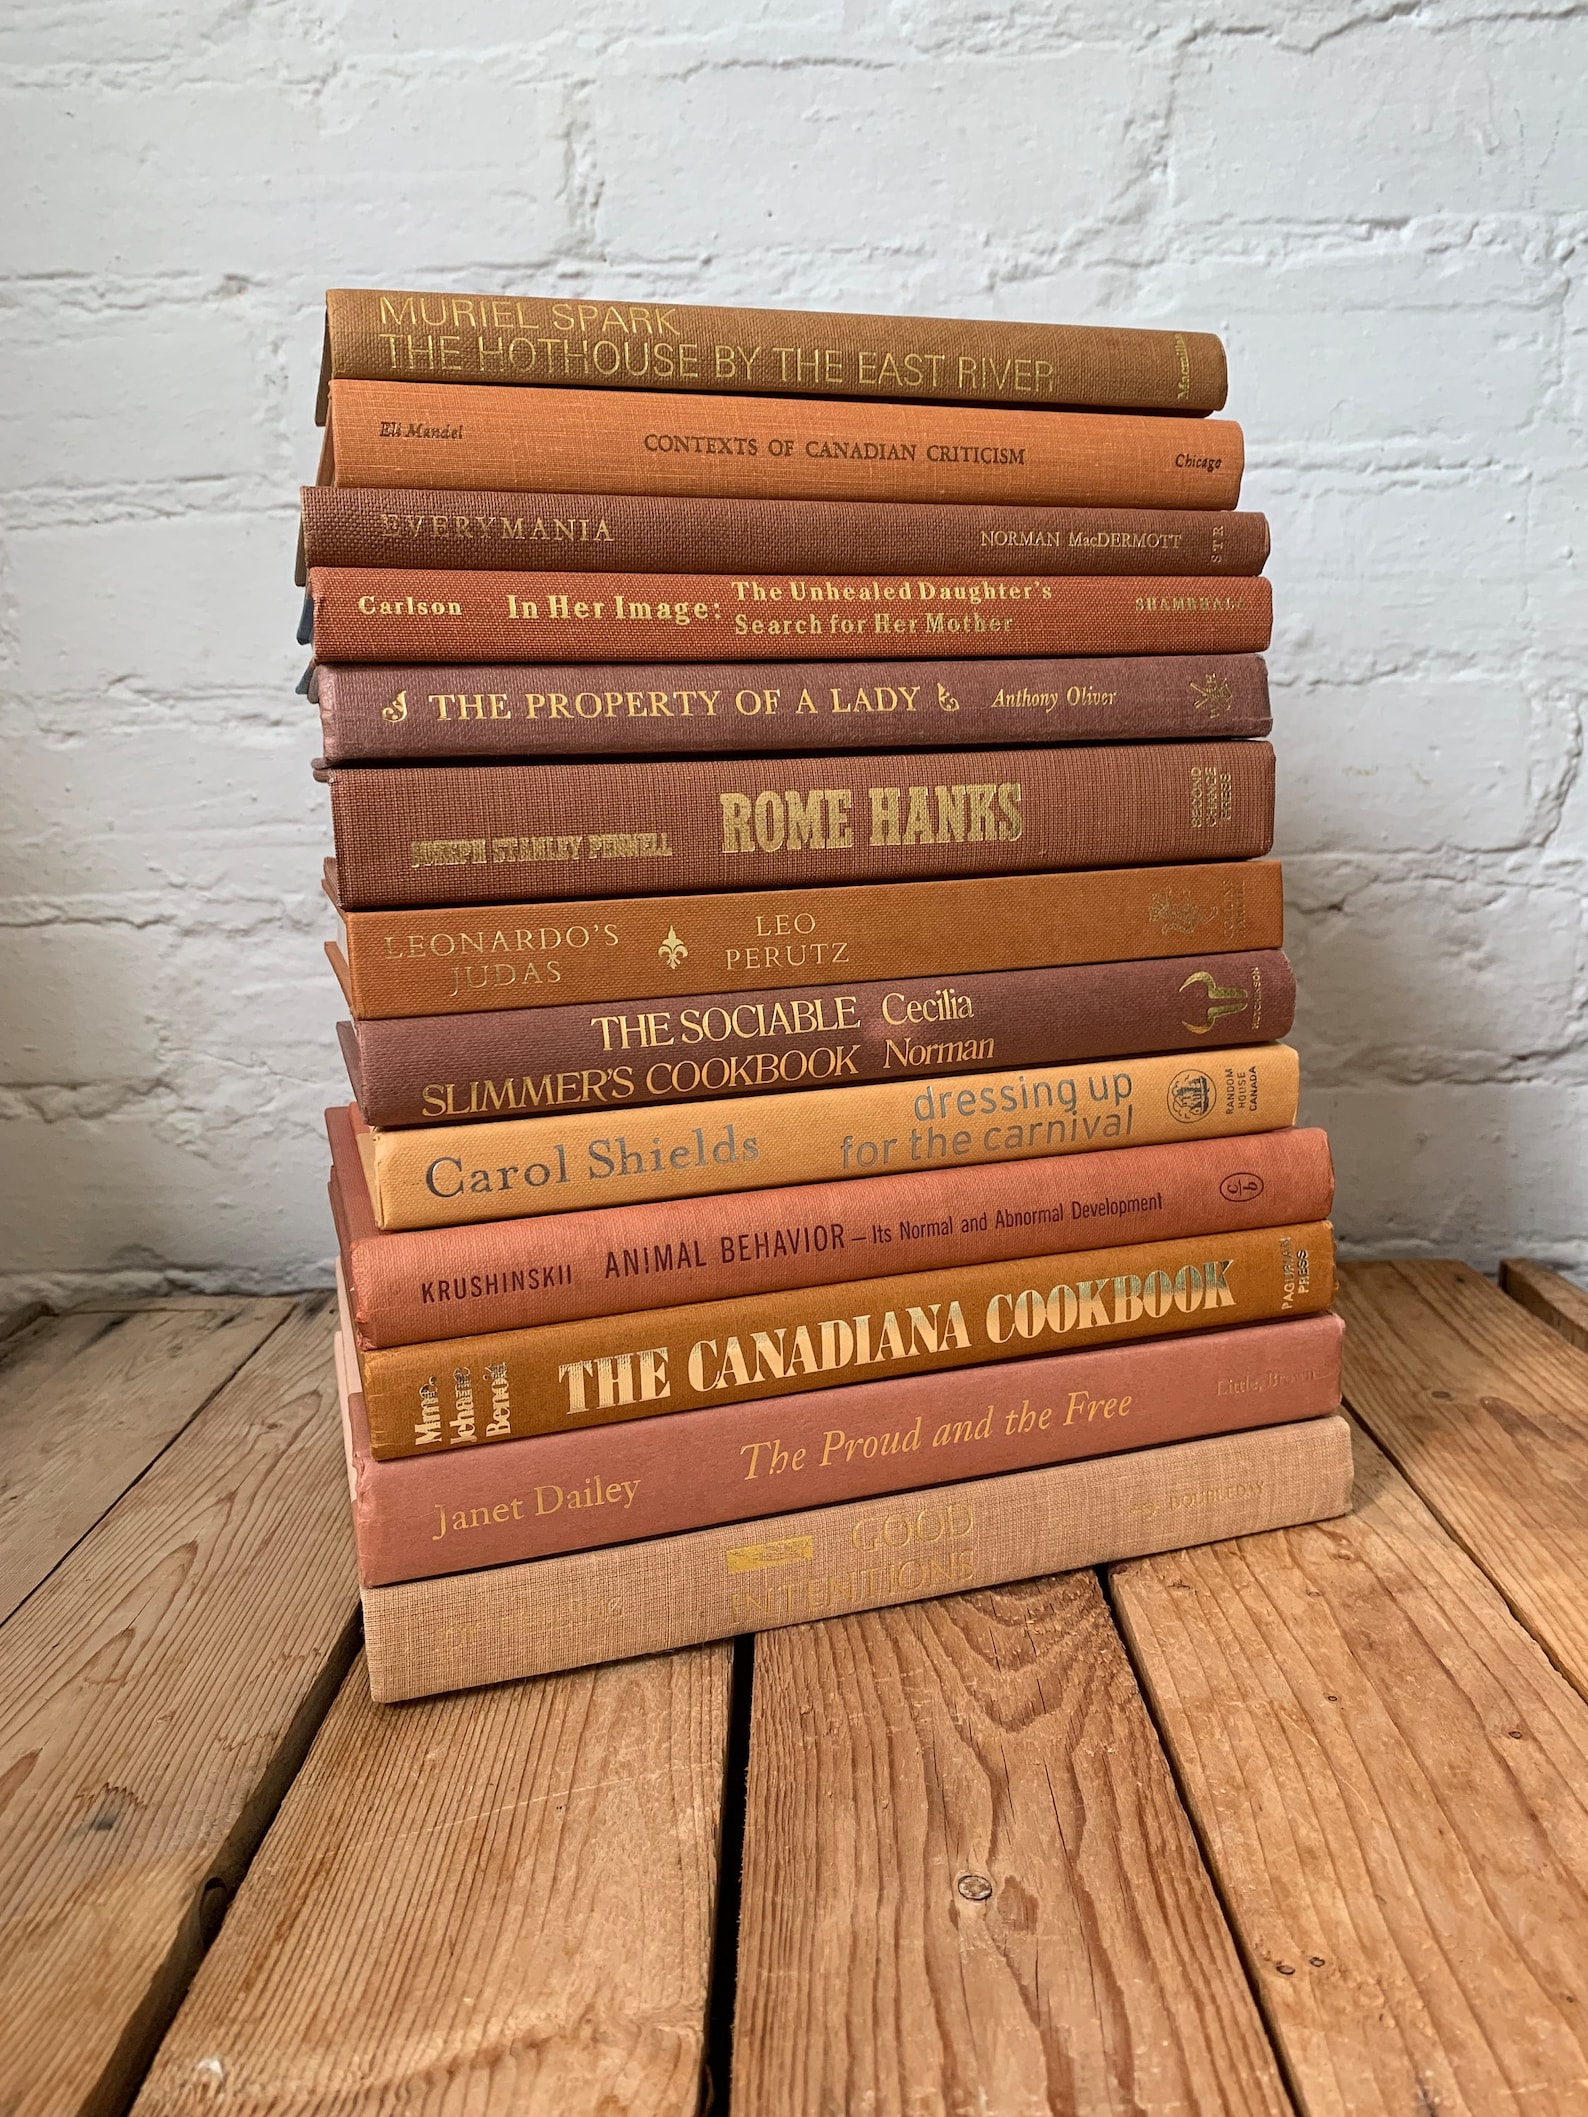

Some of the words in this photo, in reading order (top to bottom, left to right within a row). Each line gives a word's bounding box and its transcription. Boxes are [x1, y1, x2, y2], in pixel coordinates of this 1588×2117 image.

[379, 296, 539, 330] MURIEL
[552, 303, 680, 336] SPARK
[379, 333, 462, 371] THE
[478, 336, 699, 378] HOTHOUSE
[715, 345, 766, 381] BY
[773, 347, 842, 385] THE
[859, 351, 945, 389] EAST
[958, 356, 1054, 393] RIVER
[1175, 332, 1190, 400] Macmillan
[379, 421, 402, 438] Eli
[406, 423, 464, 440] Mandel
[644, 434, 758, 457] CONTEXTS
[768, 438, 795, 457] OF
[805, 440, 917, 462] CANADIAN
[927, 445, 1026, 466] CRITICISM
[1175, 453, 1223, 472] Chicago
[381, 513, 614, 542] EVERYMANIA
[980, 530, 1060, 548] NORMAN
[1069, 531, 1182, 550] MacDERMOTT
[358, 595, 463, 616] Carlson
[507, 594, 540, 619] In
[548, 595, 603, 619] Her
[614, 596, 722, 626] Image:
[731, 581, 782, 602] The
[789, 581, 911, 602] Unhealed
[919, 580, 1052, 605] Daughter's
[734, 614, 823, 635] Search
[828, 612, 866, 634] for
[874, 613, 917, 633] Her
[926, 612, 1014, 633] Mother
[429, 693, 512, 722] THE
[525, 690, 721, 720] PROPERTY
[735, 688, 781, 715] OF
[795, 688, 818, 715] A
[829, 685, 920, 713] LADY
[991, 688, 1059, 713] Anthony
[1067, 685, 1117, 707] Oliver
[719, 788, 854, 855] ROME
[869, 782, 1023, 846] HANKS
[384, 923, 620, 960] LEONARDO'S
[756, 912, 816, 937] LEO
[726, 942, 849, 971] PERUTZ
[451, 961, 562, 997] JUDAS
[1251, 967, 1262, 1030] HUTCHINSON
[591, 1011, 675, 1051] THE
[681, 996, 861, 1045] SOCIABLE
[882, 988, 975, 1026] Cecilia
[884, 1037, 995, 1070] Norman
[422, 1065, 634, 1118] SLIMMER'S
[646, 1043, 861, 1095] COOKBOOK
[914, 1074, 1077, 1122] dressing
[1089, 1071, 1133, 1103] up
[1225, 1068, 1234, 1115] RANDOM
[1237, 1072, 1246, 1109] HOUSE
[1249, 1066, 1258, 1112] CANADA
[841, 1134, 900, 1170] for
[910, 1127, 971, 1162] the
[984, 1104, 1134, 1151] carnival
[425, 1143, 566, 1199] Carol
[588, 1124, 759, 1181] Shields
[604, 1239, 708, 1279] ANIMAL
[872, 1223, 892, 1245] Its
[899, 1214, 953, 1241] Normal
[961, 1213, 988, 1234] and
[995, 1203, 1064, 1231] Abnormal
[1072, 1191, 1164, 1221] Development
[421, 1264, 572, 1304] KRUSHINSKII
[1297, 1250, 1310, 1294] PRESS
[559, 1346, 671, 1416] THE
[688, 1299, 972, 1392] CANADIANA
[986, 1259, 1236, 1345] COOKBOOK
[739, 1438, 805, 1481] The
[819, 1417, 922, 1466] Proud
[932, 1405, 993, 1447] and
[1004, 1399, 1052, 1436] the
[1063, 1390, 1132, 1427] Free
[432, 1498, 523, 1541] Janet
[534, 1474, 642, 1516] Dailey
[852, 1503, 973, 1551] GOOD
[731, 1551, 974, 1624] INTENTIONS
